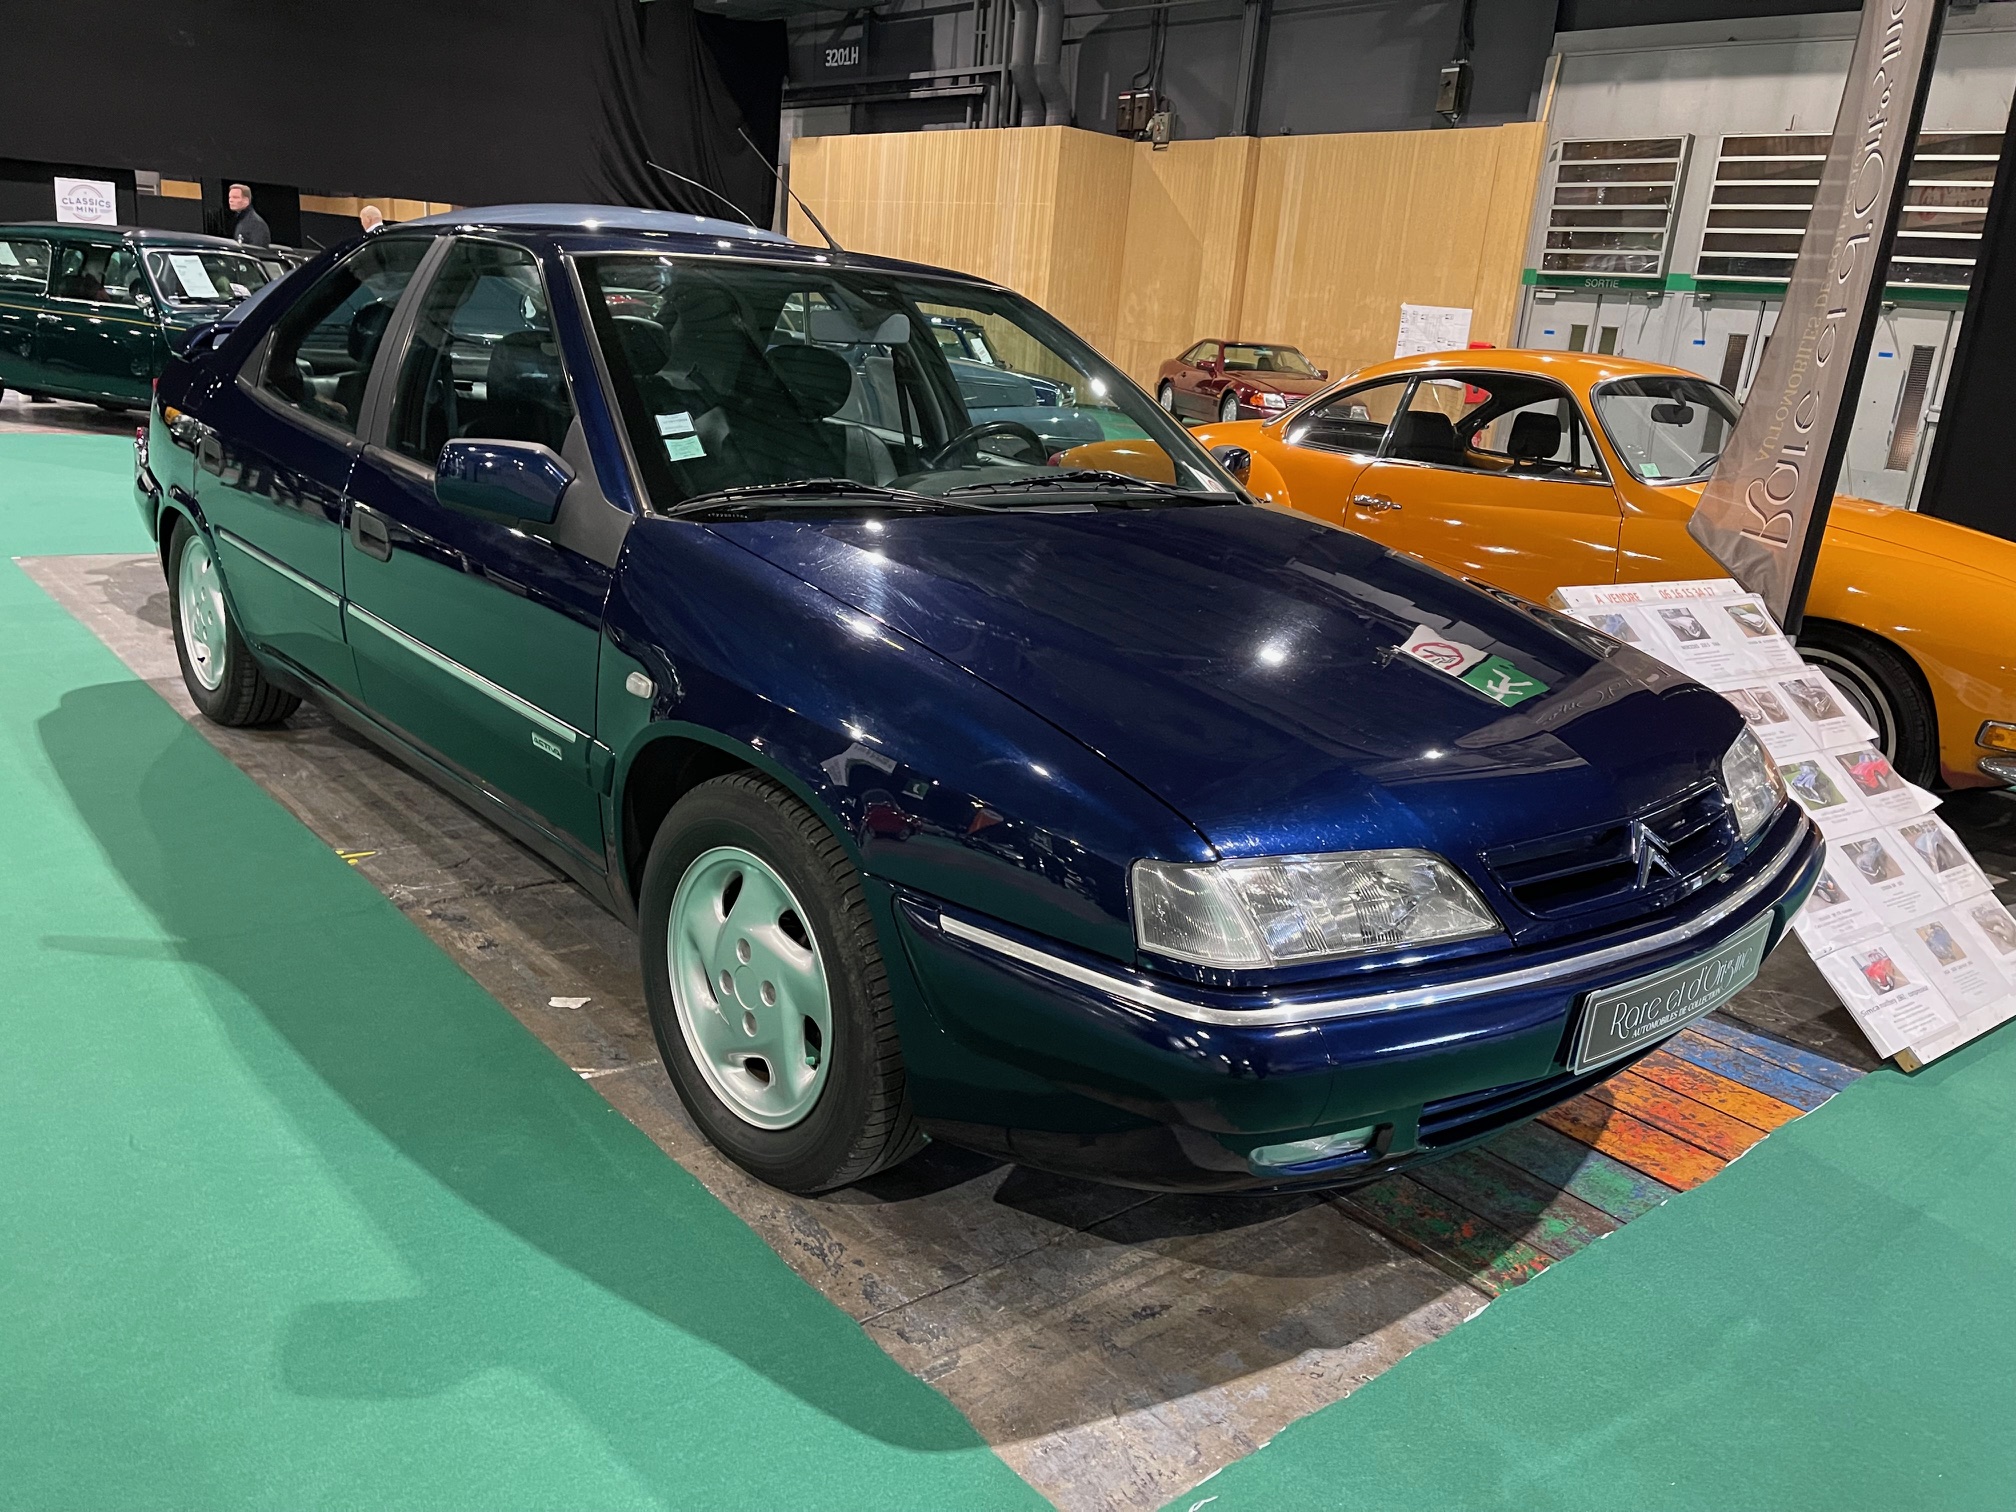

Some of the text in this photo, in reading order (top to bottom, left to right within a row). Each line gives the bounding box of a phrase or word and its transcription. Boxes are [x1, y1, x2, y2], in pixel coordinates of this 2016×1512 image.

[825, 46, 859, 67] 3201H
[62, 197, 111, 208] CLASSICS
[1584, 278, 1619, 288] SORTIE
[1596, 595, 1603, 605] A
[1607, 592, 1642, 604] VENDRE
[1659, 590, 1671, 599] 06
[1671, 588, 1683, 599] 16
[1683, 588, 1694, 598] 15
[1704, 586, 1716, 597] 17
[1610, 996, 1662, 1039] Rare
[1688, 947, 1753, 999] d'Origine
[1632, 988, 1722, 1039] AUTOMOBILES DE COLLECTION
[1860, 1003, 1881, 1017] Simca
